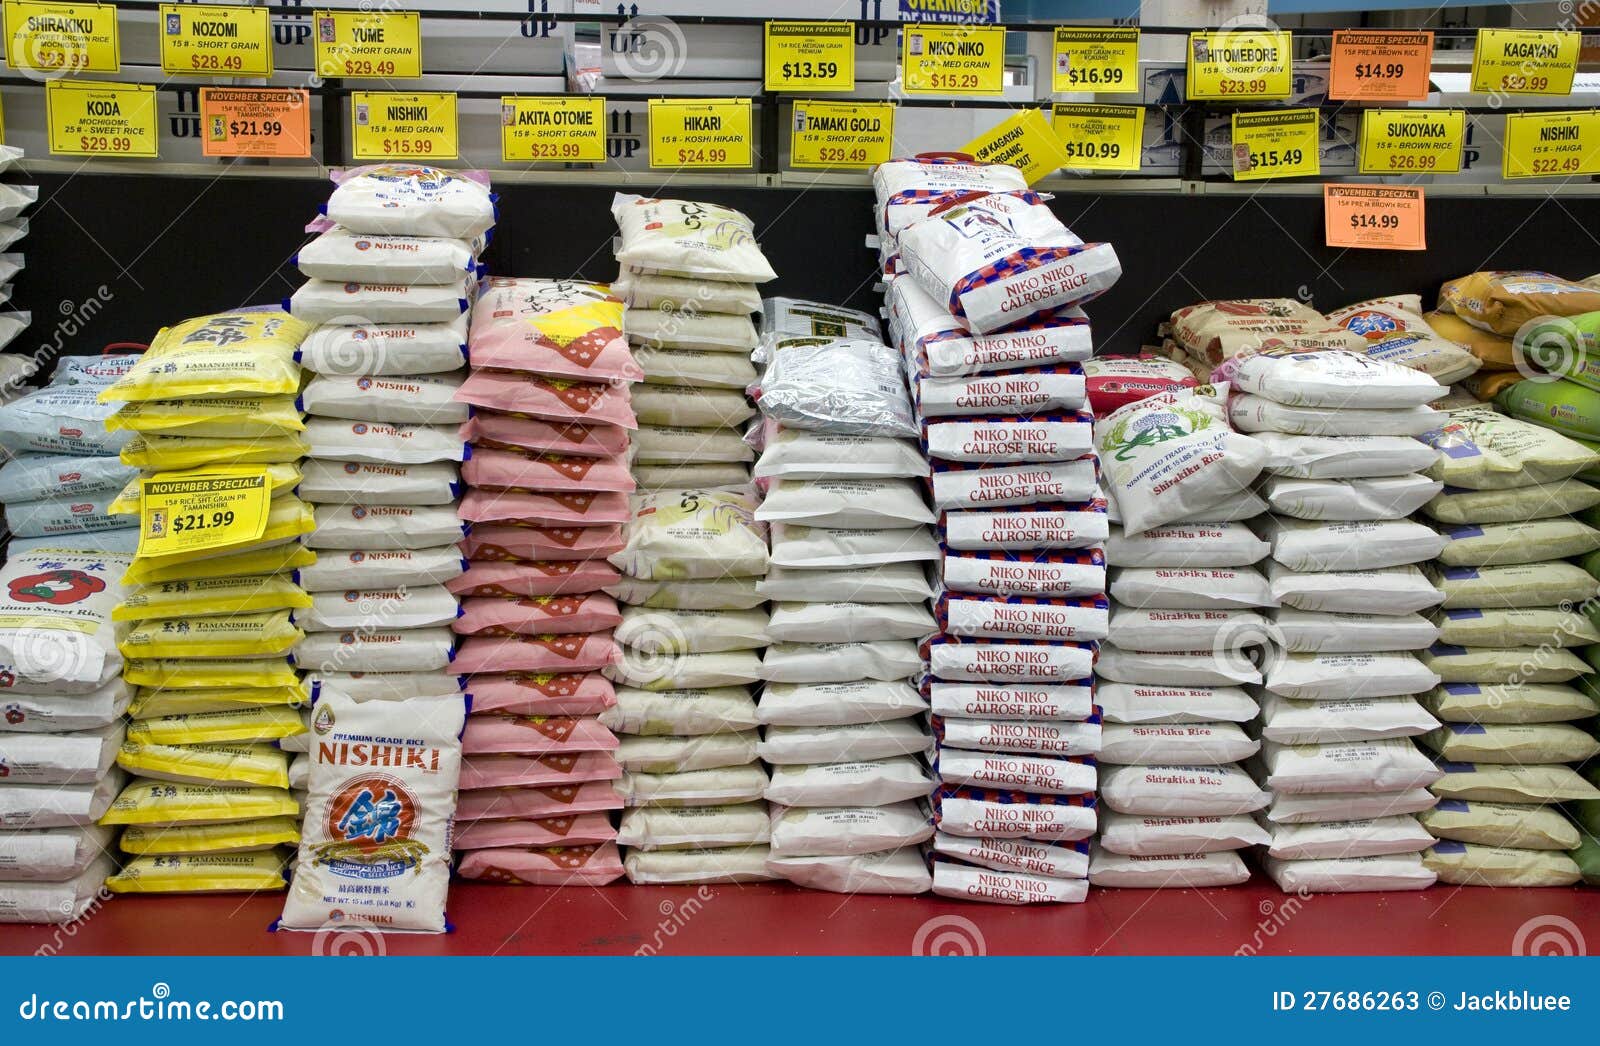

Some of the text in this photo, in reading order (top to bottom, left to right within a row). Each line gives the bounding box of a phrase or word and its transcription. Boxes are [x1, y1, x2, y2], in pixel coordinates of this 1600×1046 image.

[27, 16, 93, 34] SHIRAKIKU
[192, 21, 238, 38] NOZOMI
[274, 24, 312, 46] UP
[352, 28, 385, 43] YUME
[1340, 35, 1425, 44] NOVEMBER SPECIAL!
[197, 41, 260, 50] SHORT GRAIN
[384, 47, 412, 55] GRAIN
[928, 41, 984, 56] NIKO NIKO
[1503, 43, 1559, 59] KAGAYAKI
[37, 50, 90, 67] $23.99
[191, 54, 242, 70] $28.49
[1207, 47, 1277, 63] HITOMEBORE
[345, 60, 395, 75] $29.49
[782, 61, 837, 80] $13.59
[1226, 65, 1284, 74] SHORT GRAIN
[1355, 63, 1403, 80] $14.99
[931, 73, 978, 88] $15.29
[1069, 67, 1122, 86] $16.99
[1220, 79, 1266, 94] $23.99
[210, 92, 258, 101] NOVEMBER
[87, 100, 121, 117] KODA
[387, 106, 428, 121] NISHIKI
[79, 118, 129, 126] MOCHIGOME
[518, 111, 593, 126] AKITA OTOME
[684, 117, 721, 131] HIKARI
[807, 117, 880, 132] TAMAKI GOLD
[1280, 114, 1314, 122] FEATURES
[90, 126, 145, 136] SWEET RICE
[230, 120, 282, 138] $21.99
[394, 126, 444, 134] MED GRAIN
[570, 130, 597, 138] GRAIN
[1387, 122, 1446, 138] SUKOYAKA
[1540, 126, 1580, 141] NISHIKI
[80, 136, 131, 152] $29.99
[713, 135, 744, 143] HIKARI
[825, 135, 885, 143] SHORT GRAIN
[987, 126, 1024, 153] KAGAYAKI
[1433, 142, 1452, 150] RICE
[383, 139, 432, 155] $15.99
[531, 143, 580, 158] $23.99
[606, 139, 641, 158] UP
[990, 143, 1024, 164] ORGANIC
[1065, 141, 1120, 159] $10.99
[1555, 144, 1582, 153] HAIGA
[678, 148, 727, 163] $24.99
[819, 148, 867, 162] $29.49
[1015, 153, 1032, 169] OUT
[1250, 149, 1303, 169] $15.49
[1389, 155, 1436, 169] $26.99
[1532, 158, 1580, 174] $22.49
[1332, 188, 1417, 199] NOVEMBER SPECIAL!
[1350, 214, 1399, 229] $14.99
[1005, 264, 1075, 298] NIKO NIKO
[1000, 273, 1089, 313] CALROSE RICE
[184, 360, 256, 369] TAMANISHIKI
[377, 381, 420, 393] NISHIKI
[966, 381, 1040, 395] NIKO NIKO
[956, 394, 1050, 408] CALROSE RICE
[363, 465, 408, 477] NISHIKI
[1126, 459, 1164, 490] NISHIMOTO
[1153, 452, 1225, 496] Shirakiku Rice
[152, 478, 260, 494] NOVEMBER SPECIAL!
[213, 495, 235, 503] GRAIN
[173, 510, 235, 534] $21.99
[992, 517, 1064, 529] NIKO NIKO
[982, 530, 1074, 542] CALROSE RICE
[1149, 611, 1228, 621] Shirakiku Rice
[196, 621, 264, 630] TAMANISHIKI
[976, 651, 1049, 664] NIKO NIKO
[966, 663, 1058, 676] CALROSE RICE
[1134, 689, 1186, 697] Shirakiku
[333, 733, 424, 746] PREMIUM GRADE RICE
[319, 742, 440, 771] NISHIKI
[1143, 816, 1221, 827] Shirakiku Rice
[187, 856, 255, 864] TAMANISHIKI
